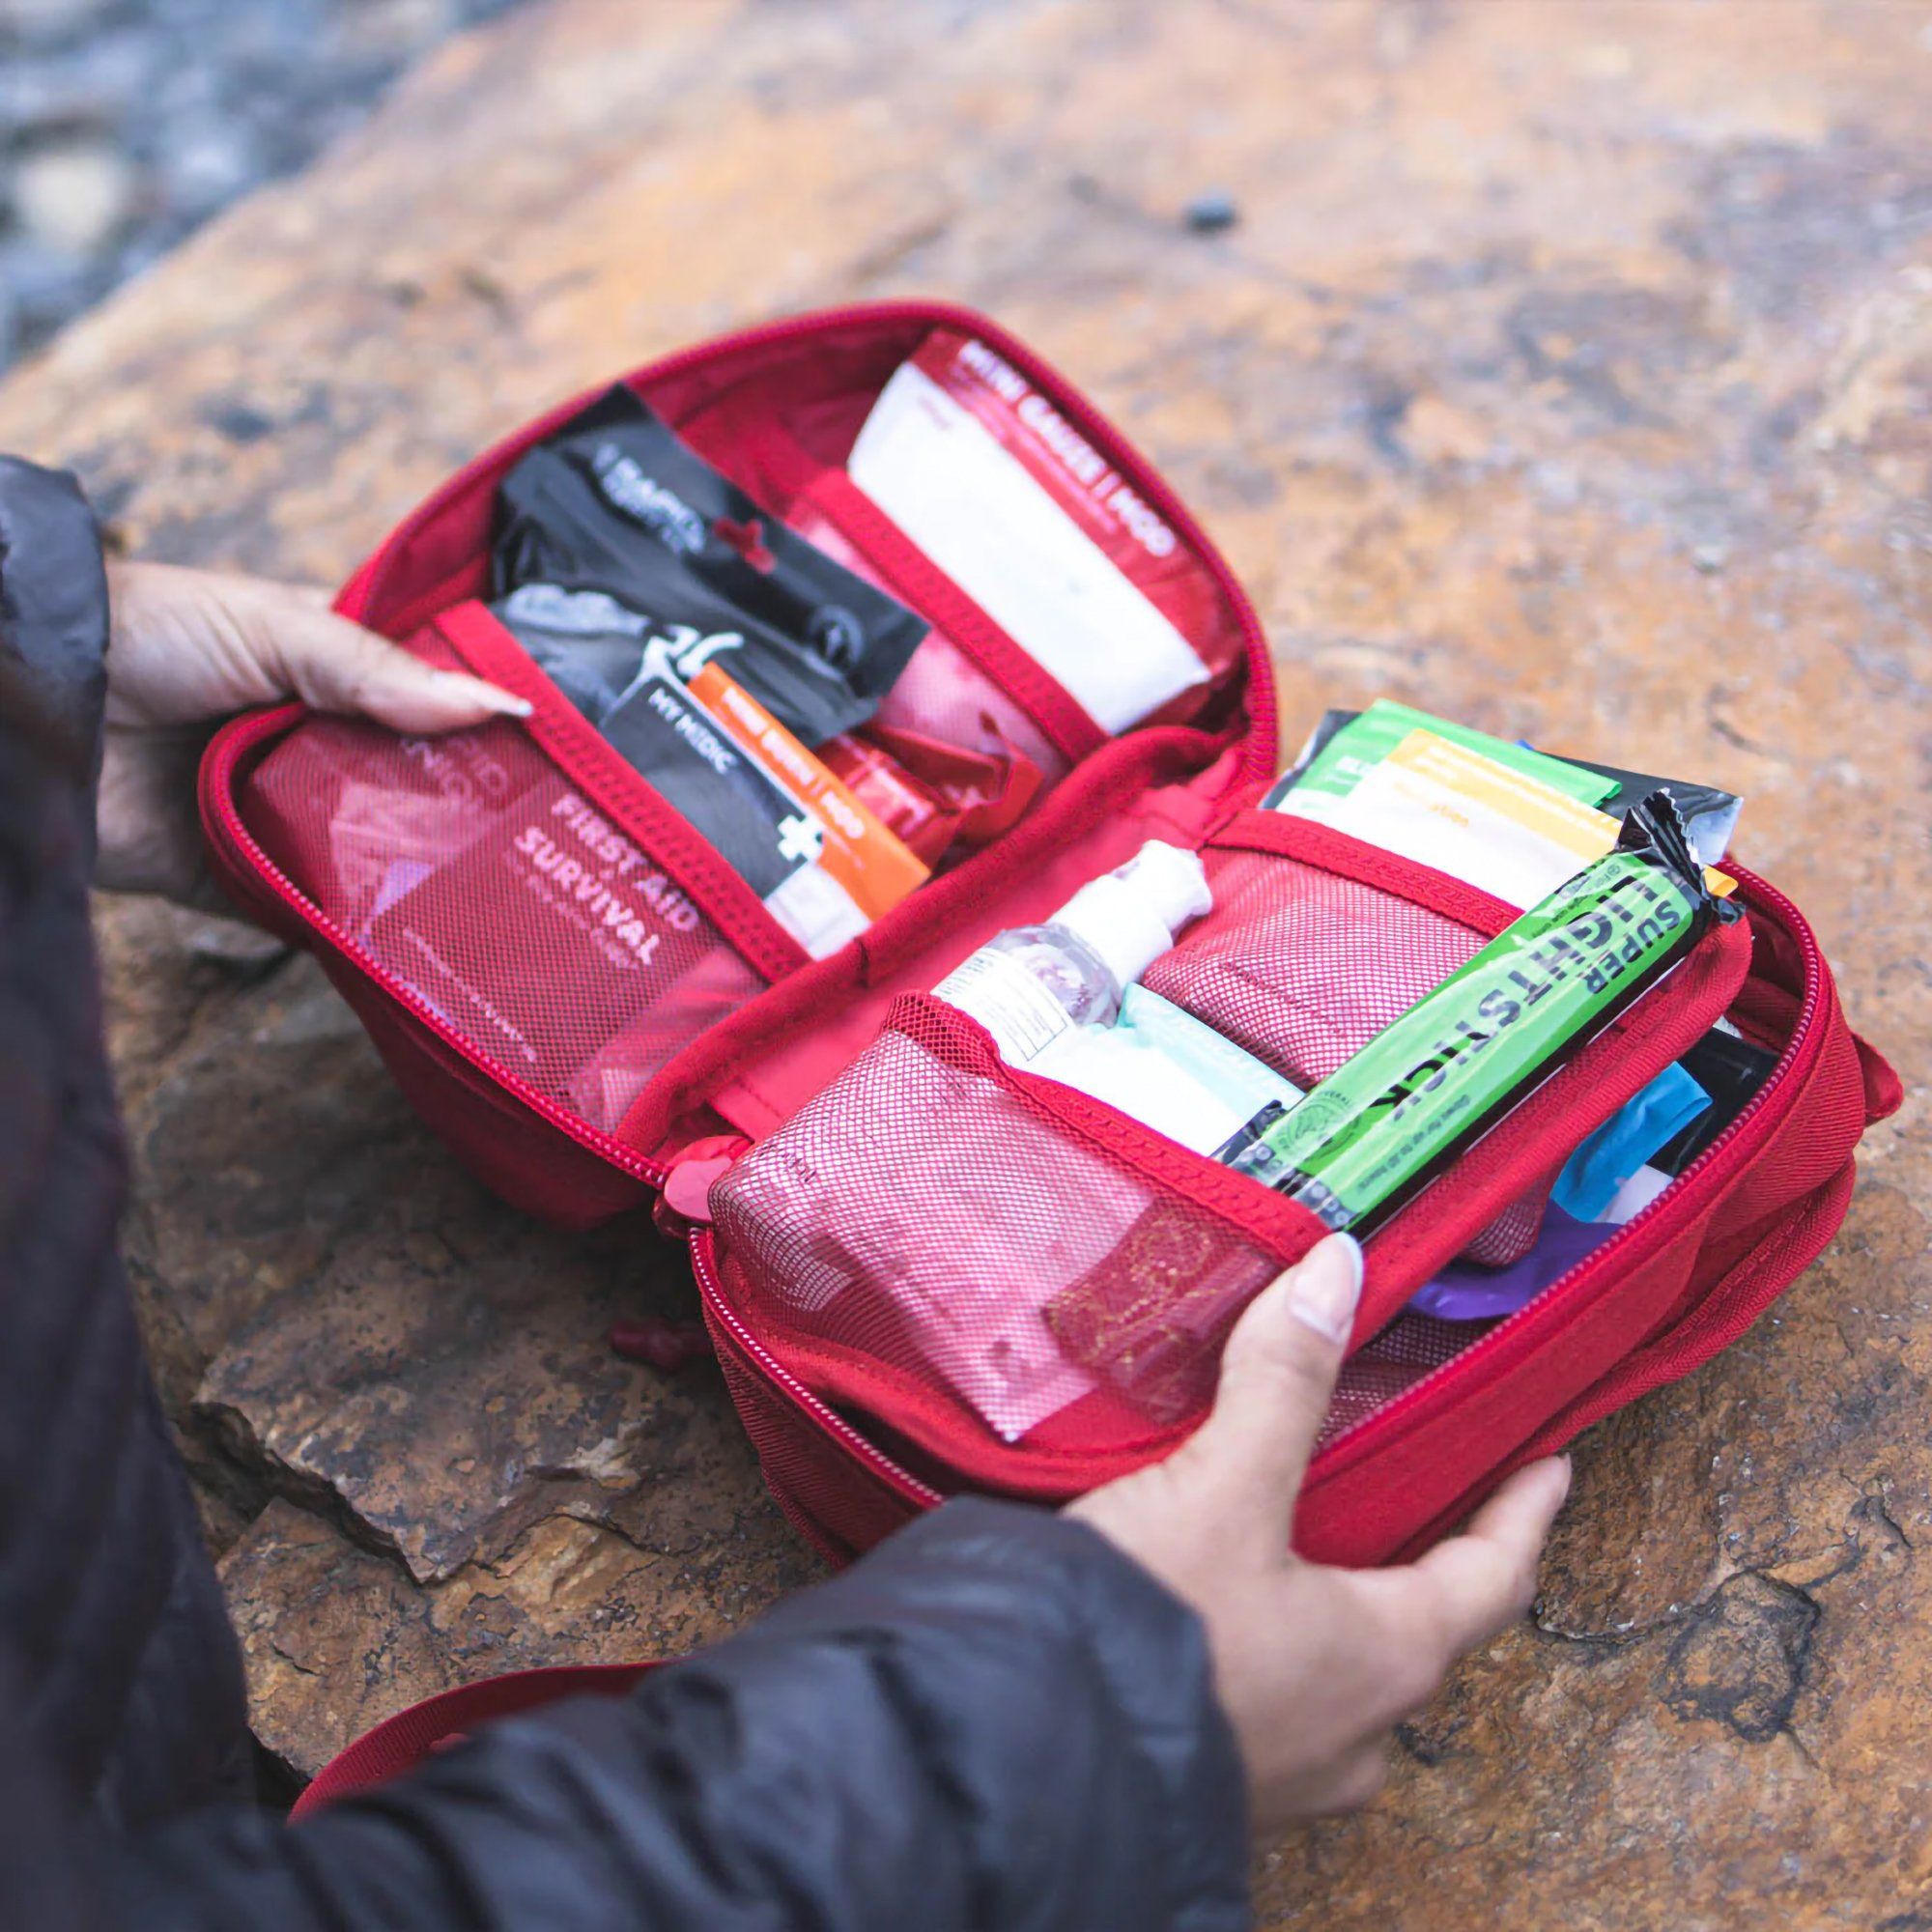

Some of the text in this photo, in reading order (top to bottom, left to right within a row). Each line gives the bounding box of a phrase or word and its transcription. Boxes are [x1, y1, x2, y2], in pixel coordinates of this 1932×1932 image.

[648, 687, 738, 774] MY MEDIC
[514, 826, 660, 966] SURVIVAL
[552, 792, 647, 874] FIRST
[632, 873, 700, 932] AID
[1367, 875, 1659, 1122] LIGHTSTICK
[1576, 899, 1681, 994] SUPER
